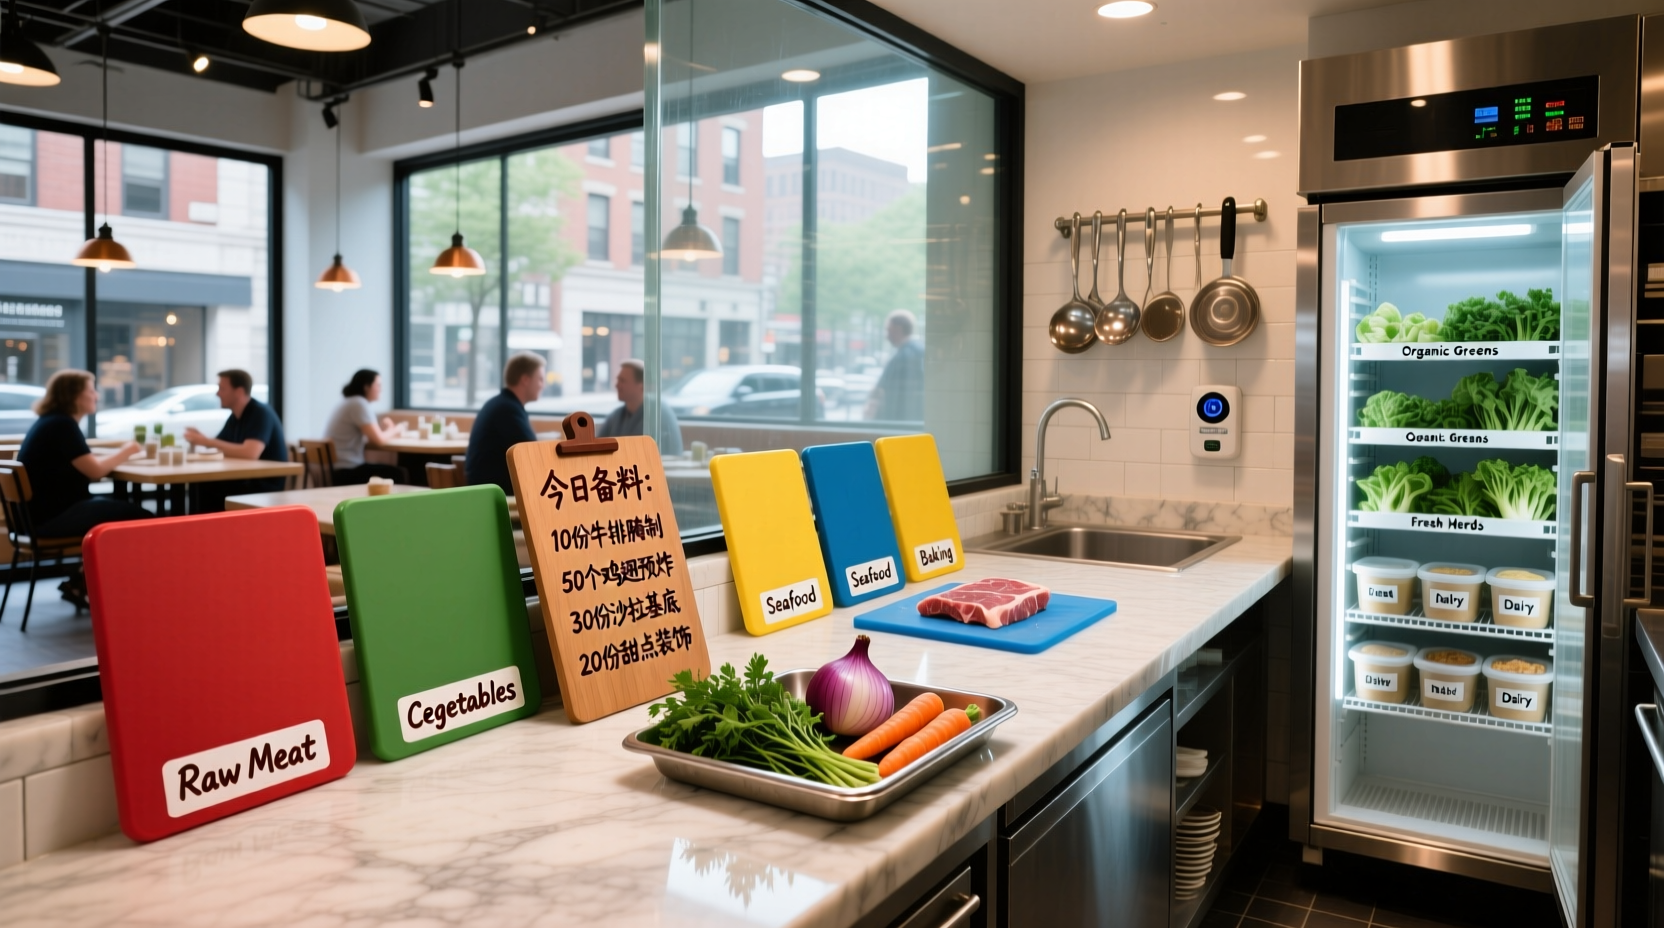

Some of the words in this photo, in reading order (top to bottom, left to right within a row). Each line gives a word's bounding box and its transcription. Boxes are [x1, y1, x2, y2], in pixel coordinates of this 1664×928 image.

[1402, 345, 1450, 359] Organic
[1453, 345, 1499, 356] Greens
[850, 561, 892, 588] Seafood
[570, 588, 682, 634] 30份沙拉基底
[766, 585, 817, 615] Seafood
[579, 625, 692, 676] 20份甜点装饰
[407, 680, 517, 729] Cegetables
[177, 763, 241, 801] Raw
[247, 734, 317, 779] Meat
